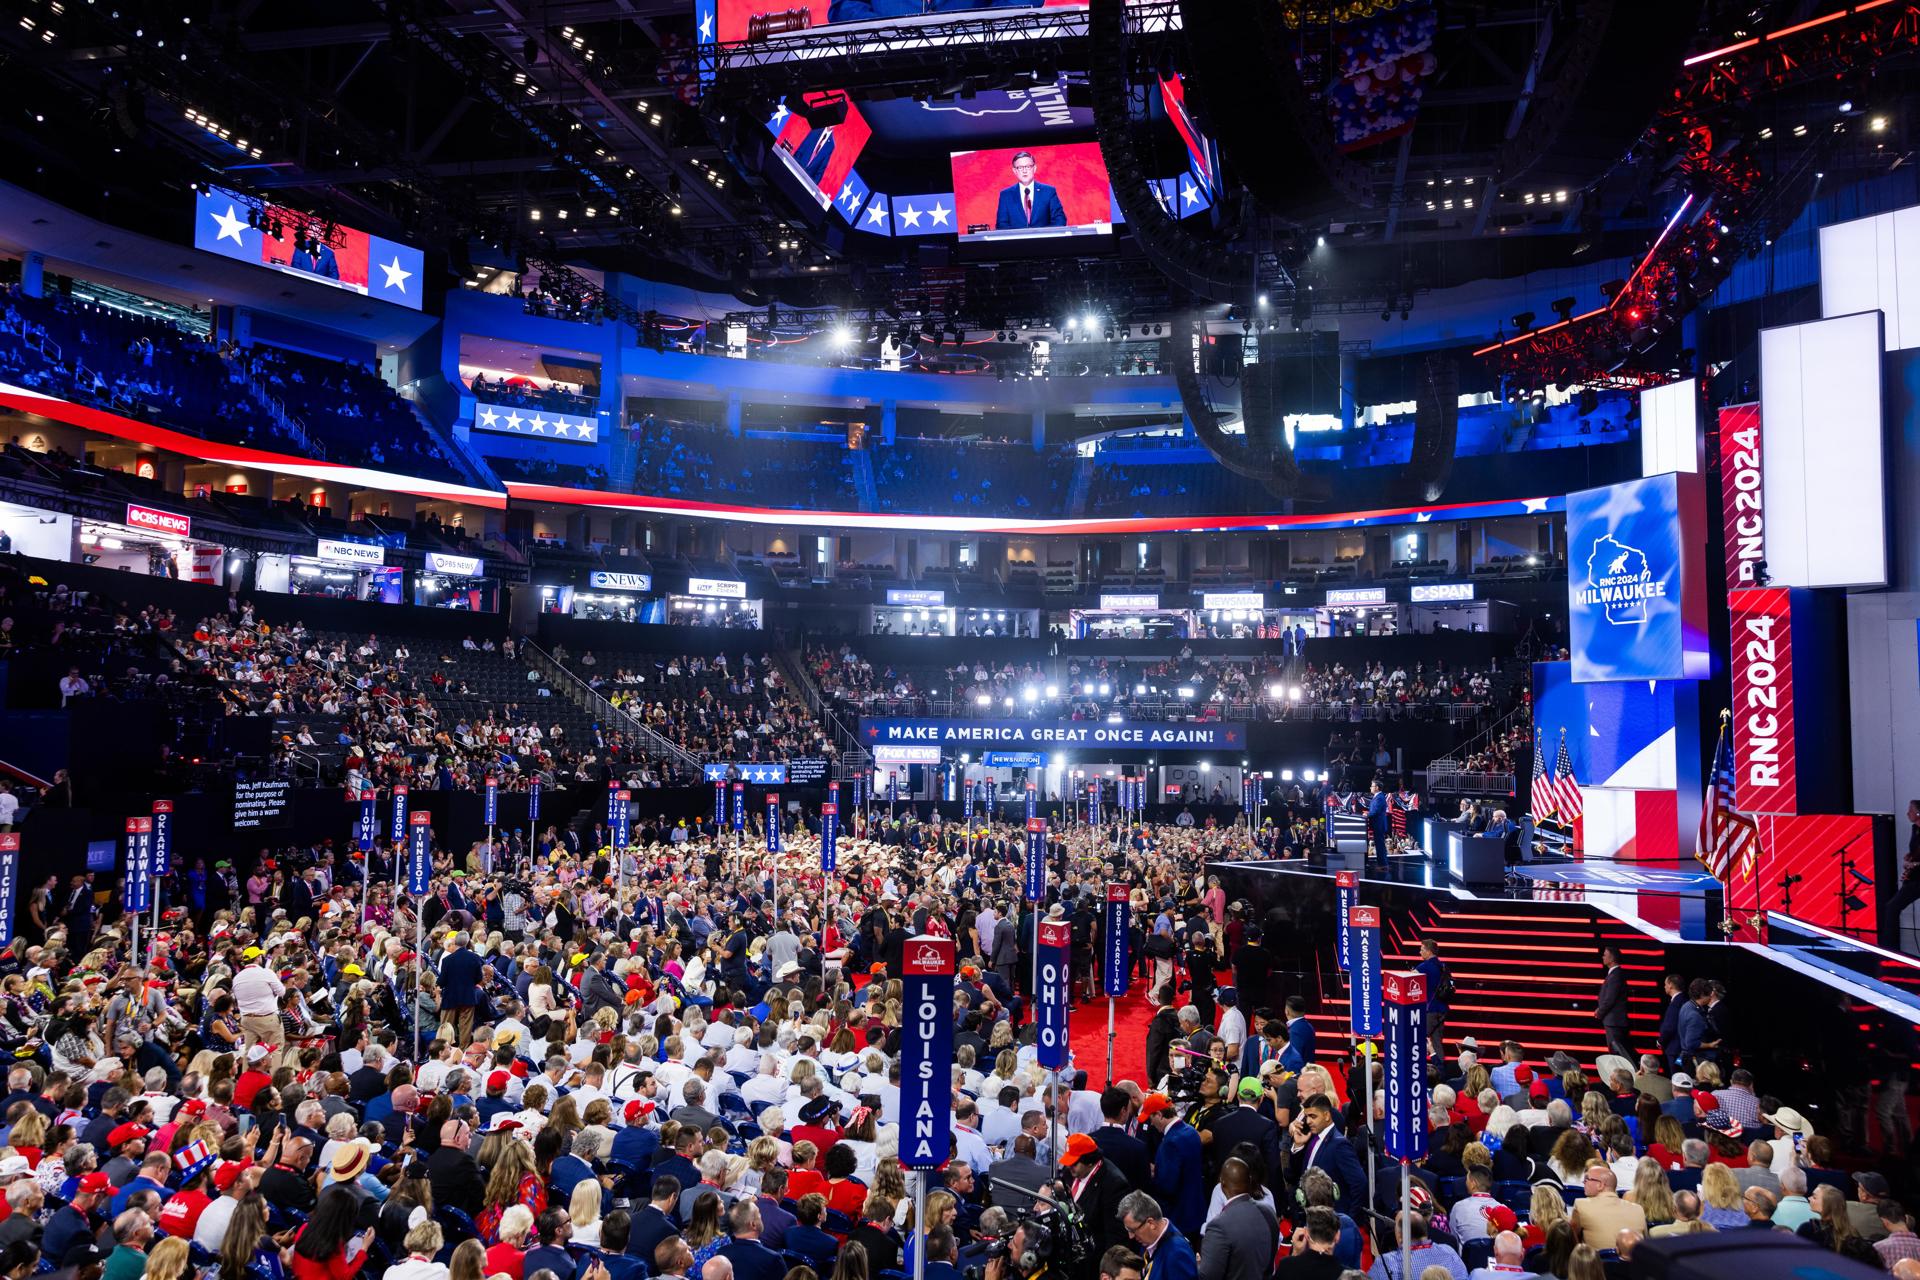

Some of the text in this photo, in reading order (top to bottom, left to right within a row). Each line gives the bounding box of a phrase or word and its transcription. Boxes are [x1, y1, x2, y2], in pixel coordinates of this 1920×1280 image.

[1733, 427, 1762, 512] 2024
[140, 511, 187, 531] CBS NEWS
[333, 546, 379, 559] NBC NEWS
[444, 560, 474, 570] PBS NEWS
[608, 574, 645, 586] NEWS
[1110, 597, 1156, 606] FOX NEWS
[1206, 596, 1261, 606] NEWSMAX
[1336, 590, 1383, 601] FOX NEWS
[1575, 582, 1666, 605] MILWAUKEE
[1600, 574, 1639, 587] RNC 2024
[1746, 615, 1780, 787] RNC 2024
[883, 749, 938, 759] FOX NEWS
[888, 727, 1214, 743] MAKE AMERICA GREAT ONCE AGAIN!
[235, 800, 267, 809] nominating.
[236, 781, 290, 791] Iowa, Jeff Kaufmann,
[255, 791, 277, 799] purpose
[277, 789, 284, 797] of
[234, 810, 247, 819] give
[247, 809, 259, 817] him
[234, 819, 260, 827] welcome.
[361, 807, 370, 841] IOWA
[395, 795, 404, 838] OREGON
[619, 800, 627, 845] INDIANA
[155, 814, 167, 872] OKLAHOMA
[415, 826, 424, 892] MINNESOTA
[126, 835, 135, 907] HAWAII
[138, 835, 148, 907] HAWAII
[1030, 833, 1038, 898] WISCONSIN
[0, 854, 13, 942] MICHIGAN
[1341, 888, 1350, 966] NEBRASKA
[1113, 938, 1121, 992] CAROLINA
[1360, 929, 1371, 1031] MASSACHUSETTS
[1042, 963, 1057, 1048] OHIO
[1061, 963, 1069, 1047] OHIO
[915, 983, 937, 1158] LOUISIANA
[1389, 1006, 1399, 1150] MISSOURI
[1410, 1007, 1421, 1152] MISSOURI
